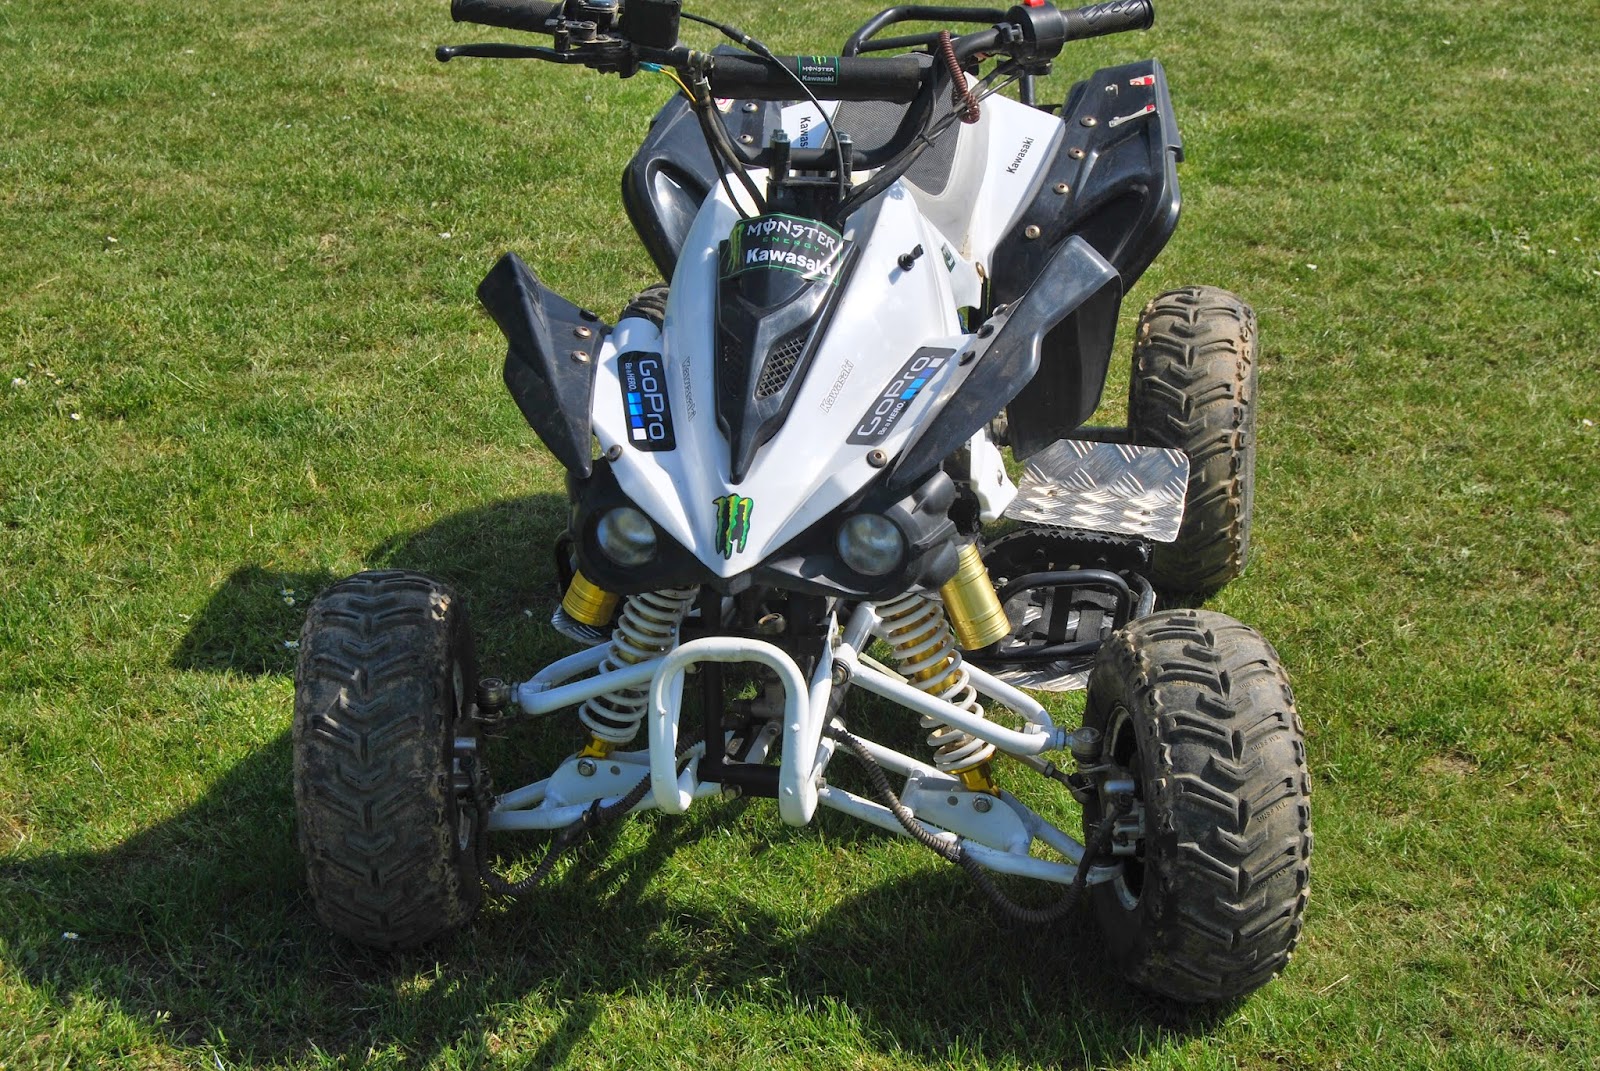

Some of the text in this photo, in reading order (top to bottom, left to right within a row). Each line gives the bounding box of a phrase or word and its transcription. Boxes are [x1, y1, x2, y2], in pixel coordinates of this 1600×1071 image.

[800, 116, 811, 149] Kawas
[1005, 136, 1035, 174] Kawasaki
[747, 218, 836, 254] MONSTER
[762, 236, 820, 252] ENERGY
[746, 247, 832, 276] Kawasaki
[638, 359, 665, 440] GoPro
[820, 358, 855, 413] Kawasaki
[857, 356, 930, 436] GoPro
[877, 427, 888, 435] Be
